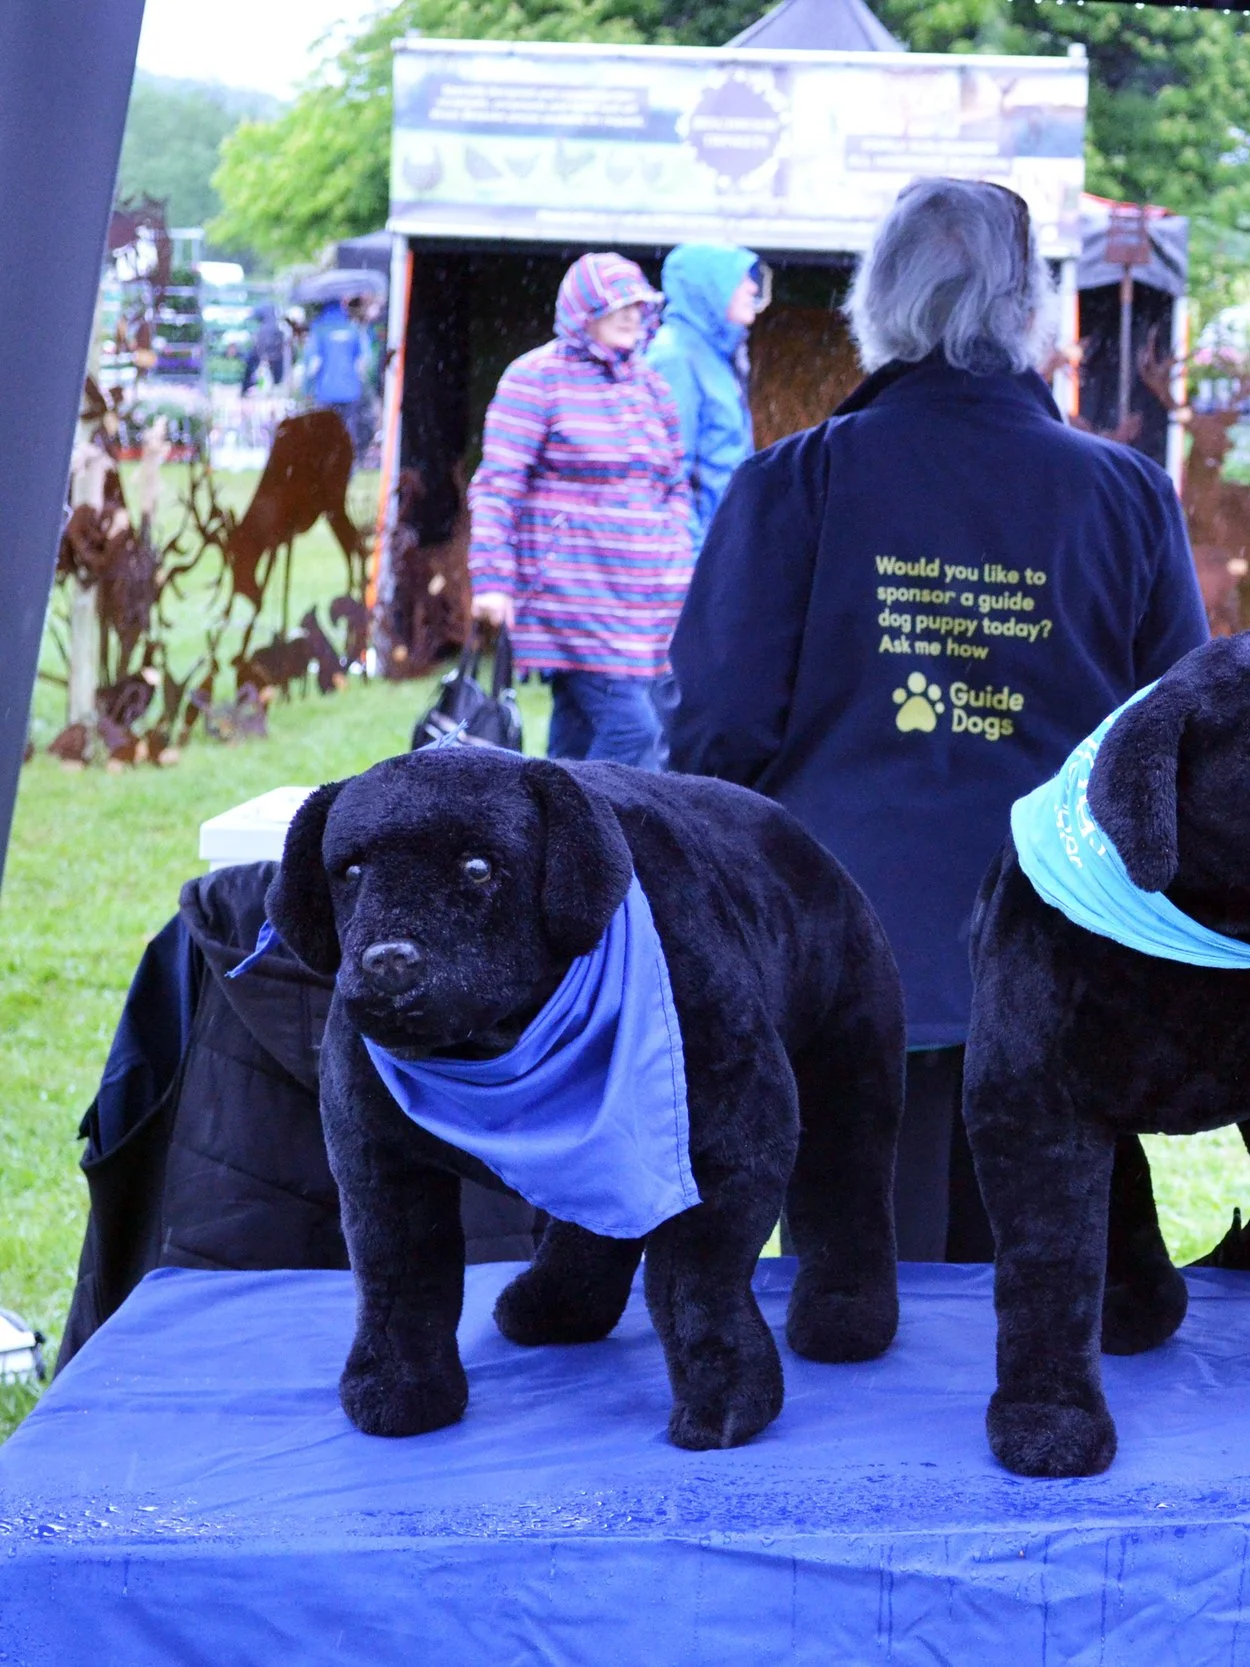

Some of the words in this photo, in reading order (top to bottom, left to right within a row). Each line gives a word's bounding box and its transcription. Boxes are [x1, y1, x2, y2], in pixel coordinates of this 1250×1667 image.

[875, 555, 941, 578] Would
[944, 564, 979, 583] you
[983, 563, 1020, 584] like
[1024, 567, 1047, 586] to
[876, 586, 956, 606] sponsor
[959, 591, 975, 607] a
[977, 591, 1035, 614] guide
[877, 607, 912, 634] dog
[915, 614, 978, 637] puppy
[981, 617, 1053, 643] today?
[878, 633, 912, 654] Ask
[914, 640, 942, 656] me
[946, 638, 990, 660] how
[949, 681, 1025, 712] Guide
[951, 708, 1014, 741] Dogs
